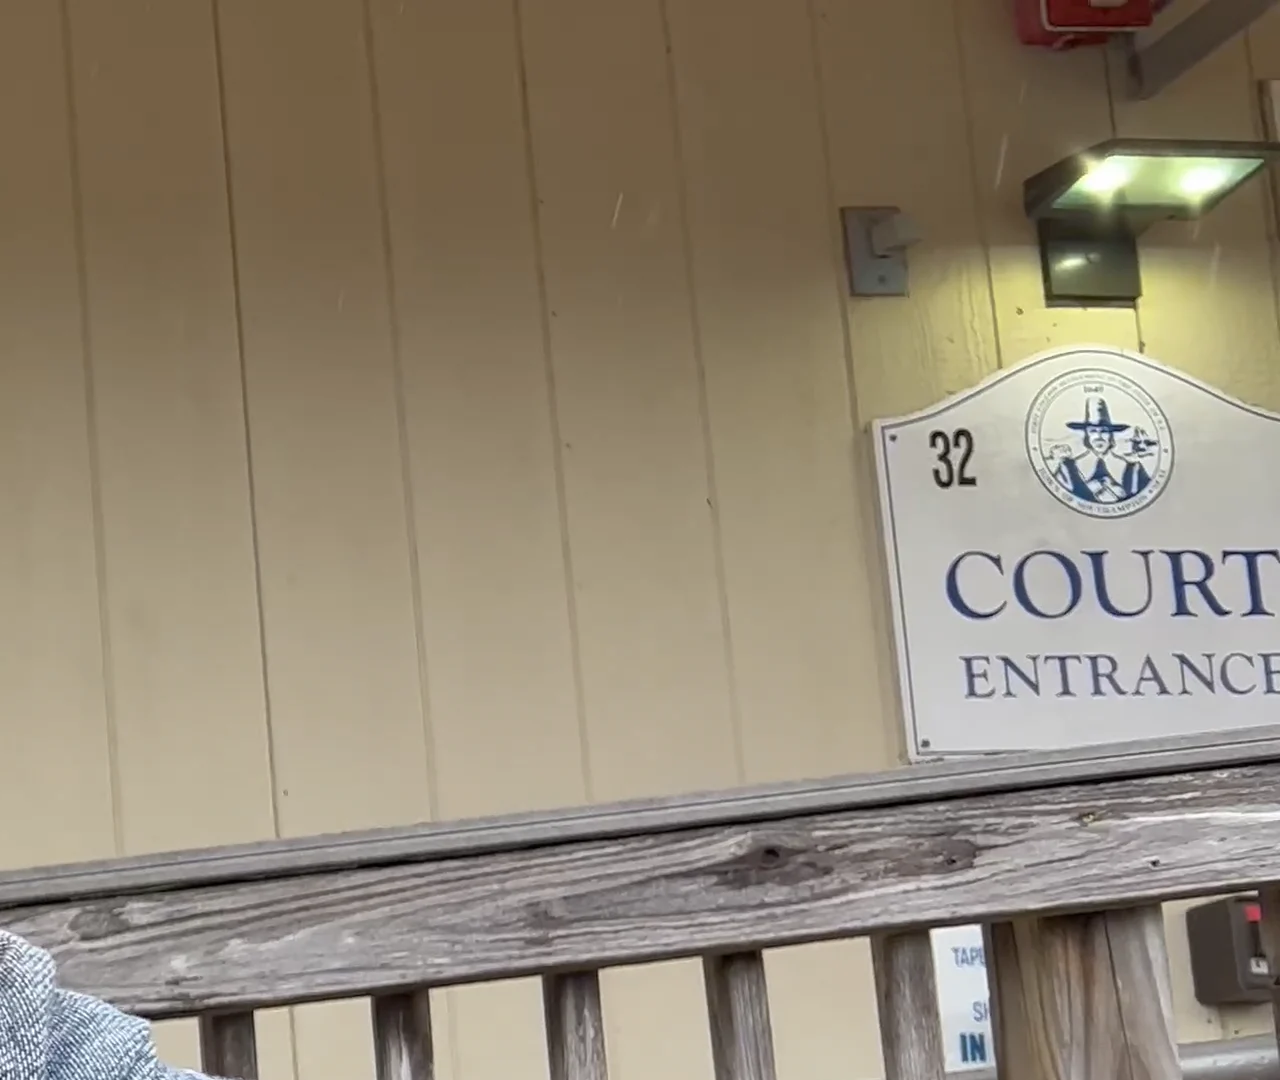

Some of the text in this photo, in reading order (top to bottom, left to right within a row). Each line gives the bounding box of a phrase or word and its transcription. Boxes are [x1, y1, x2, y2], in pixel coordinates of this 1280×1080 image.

[929, 428, 977, 488] 32
[945, 549, 1280, 620] COURT
[959, 652, 1280, 699] ENTRANCE
[959, 1032, 986, 1062] IN
